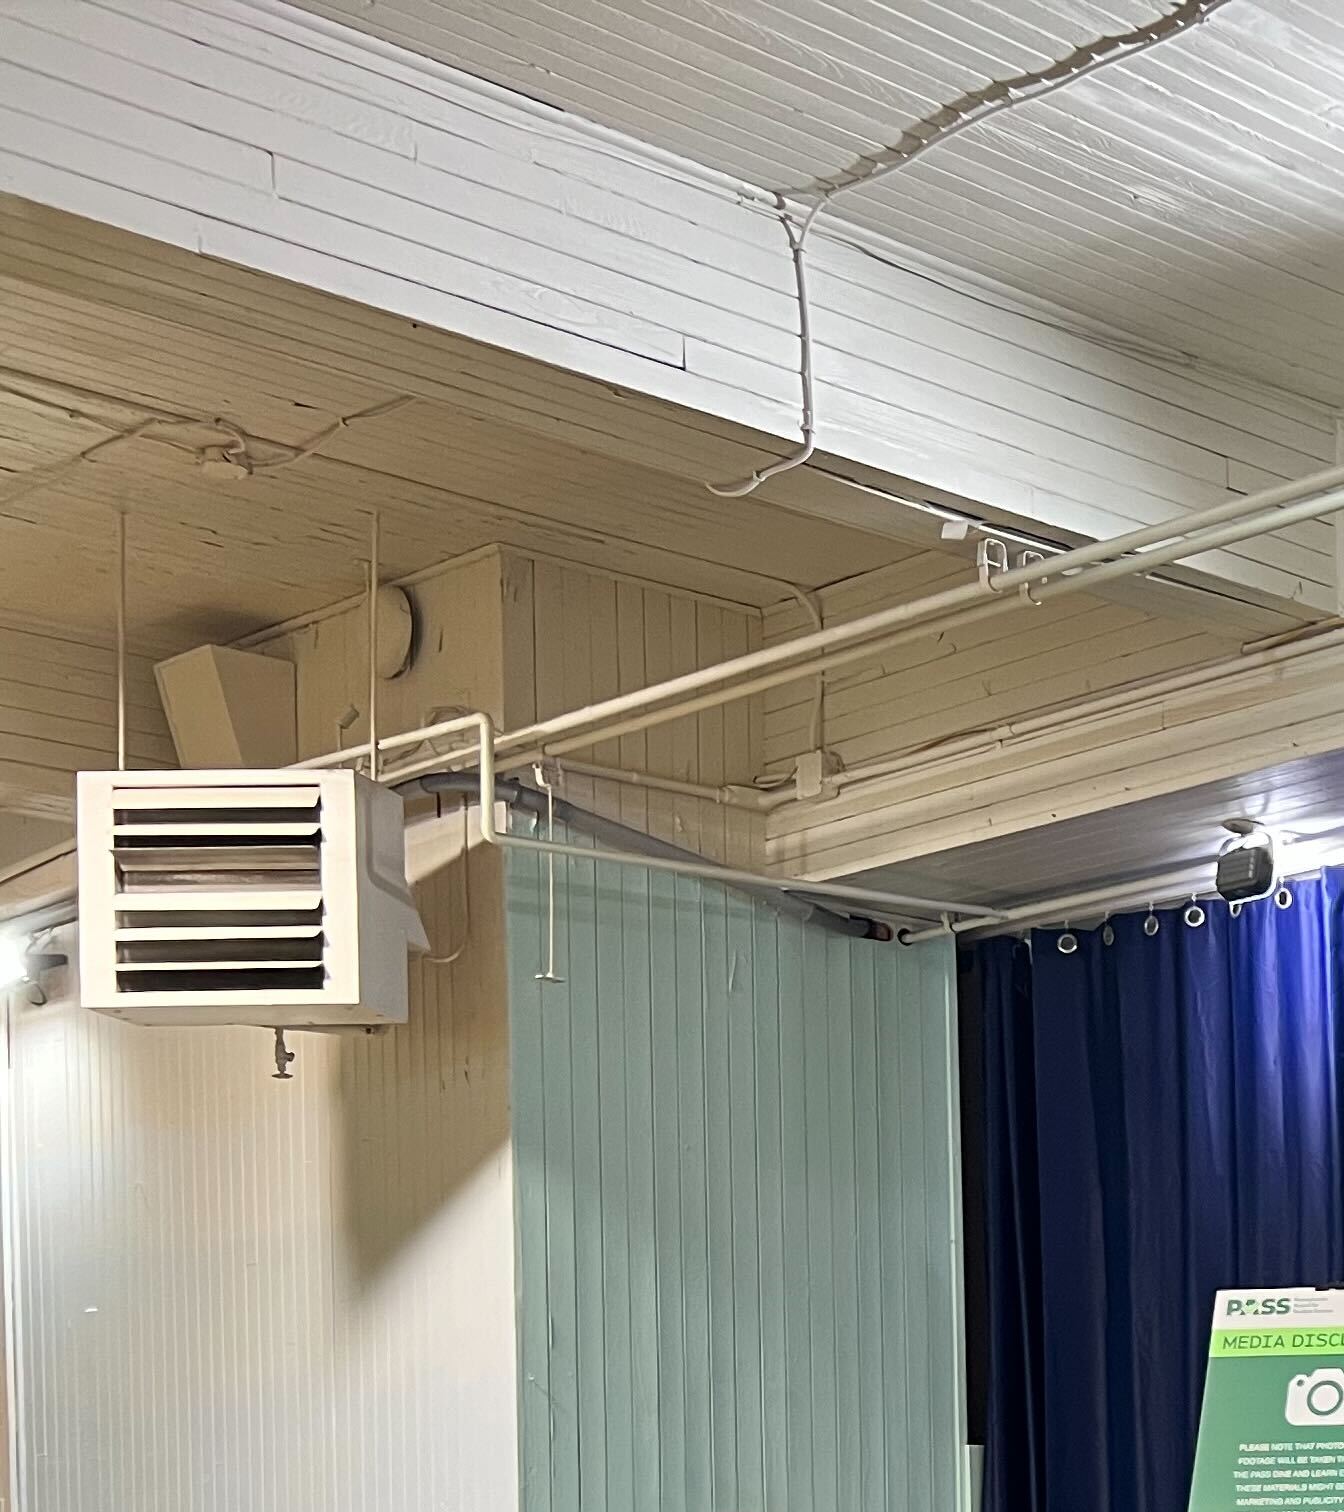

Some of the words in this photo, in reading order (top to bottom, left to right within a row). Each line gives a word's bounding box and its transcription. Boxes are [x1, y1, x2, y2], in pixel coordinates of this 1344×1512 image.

[1226, 1297, 1291, 1316] PASS
[1222, 1335, 1285, 1350] MEDIA
[1239, 1443, 1270, 1452] PLEASE
[1271, 1442, 1293, 1451] NOTE
[1238, 1456, 1276, 1465] FOOTAGE
[1233, 1470, 1249, 1479] THE
[1250, 1470, 1271, 1478] PASS
[1292, 1469, 1310, 1478] AND
